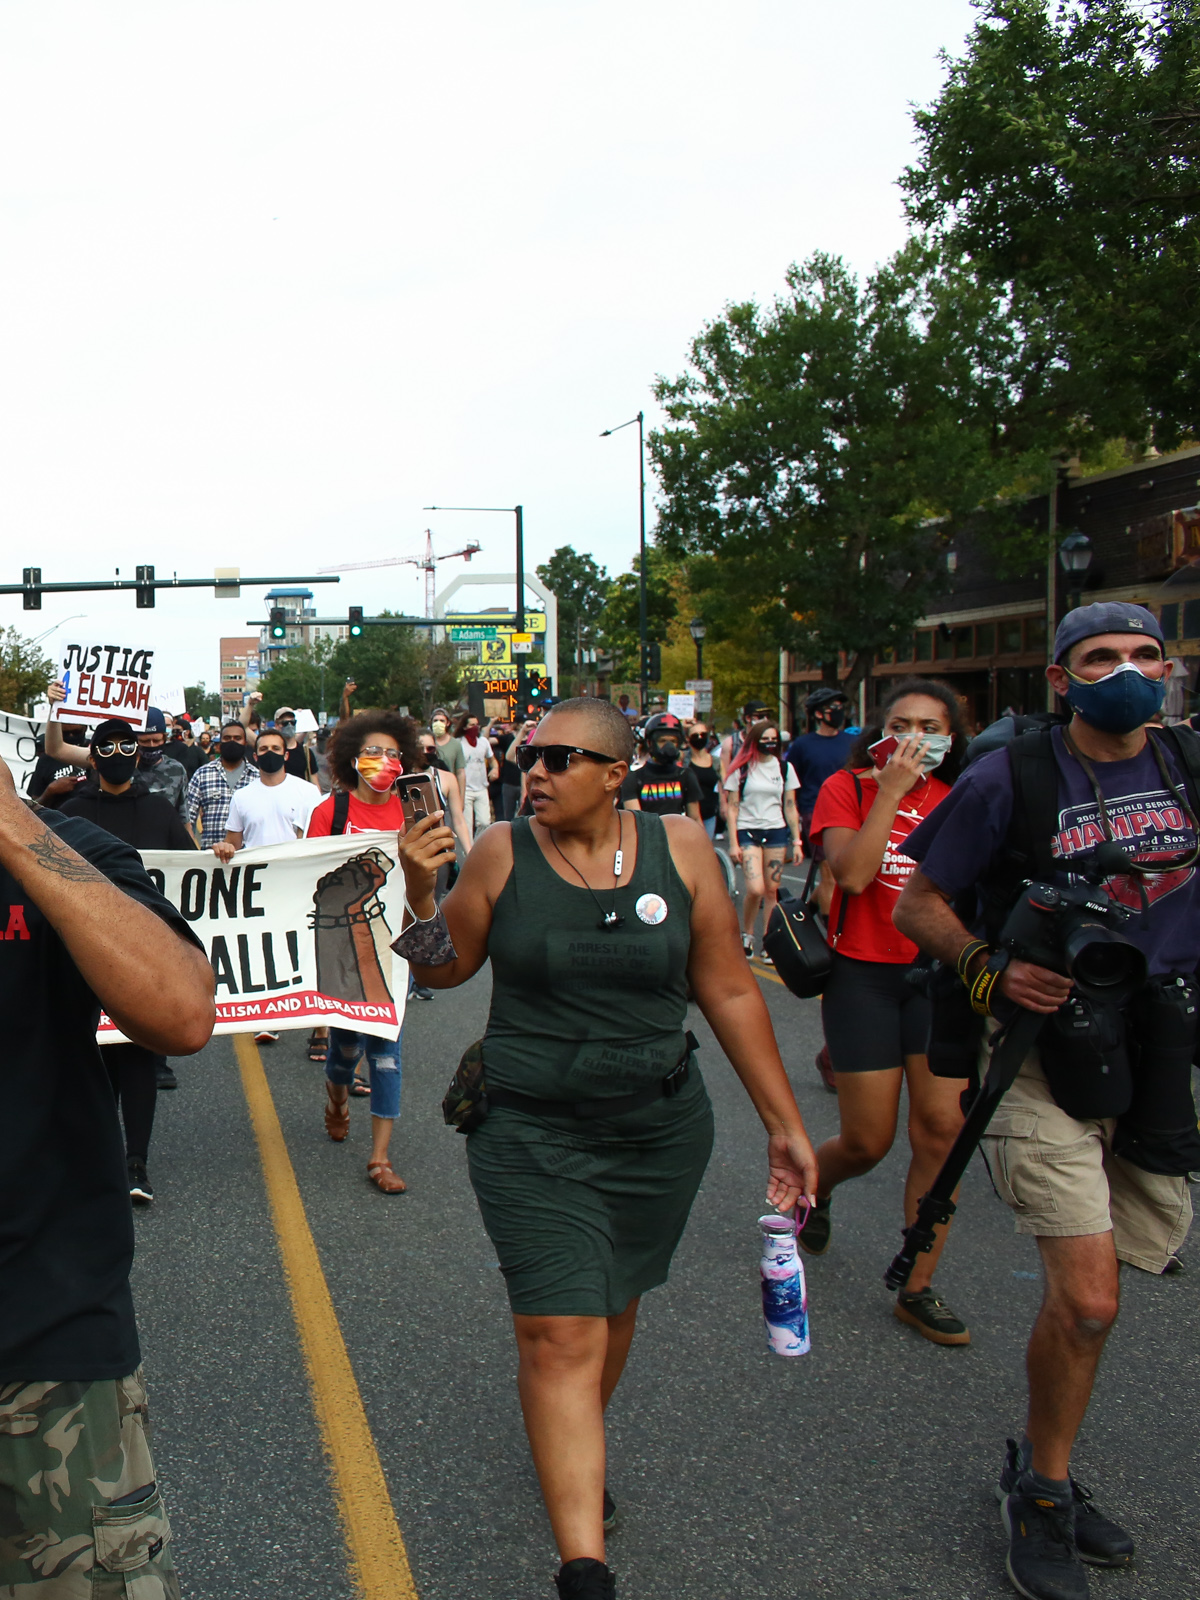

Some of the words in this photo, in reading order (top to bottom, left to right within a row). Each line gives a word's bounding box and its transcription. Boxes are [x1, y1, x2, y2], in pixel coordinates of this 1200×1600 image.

[459, 629, 485, 640] Adams
[63, 644, 153, 680] JUSTICE
[77, 671, 151, 711] ELIJAH
[1076, 813, 1101, 823] 2004
[1106, 803, 1143, 816] WORLD
[1164, 834, 1186, 845] Sox
[181, 863, 268, 921] ONE
[1086, 901, 1108, 912] Nikon
[568, 942, 618, 955] ARREST
[625, 944, 650, 956] THE
[214, 930, 303, 995] ALL!
[571, 956, 623, 968] KILLERS
[976, 972, 992, 1000] Nikon
[215, 1004, 261, 1018] ALISM
[265, 998, 301, 1013] AND
[305, 995, 392, 1018] LIBERATION
